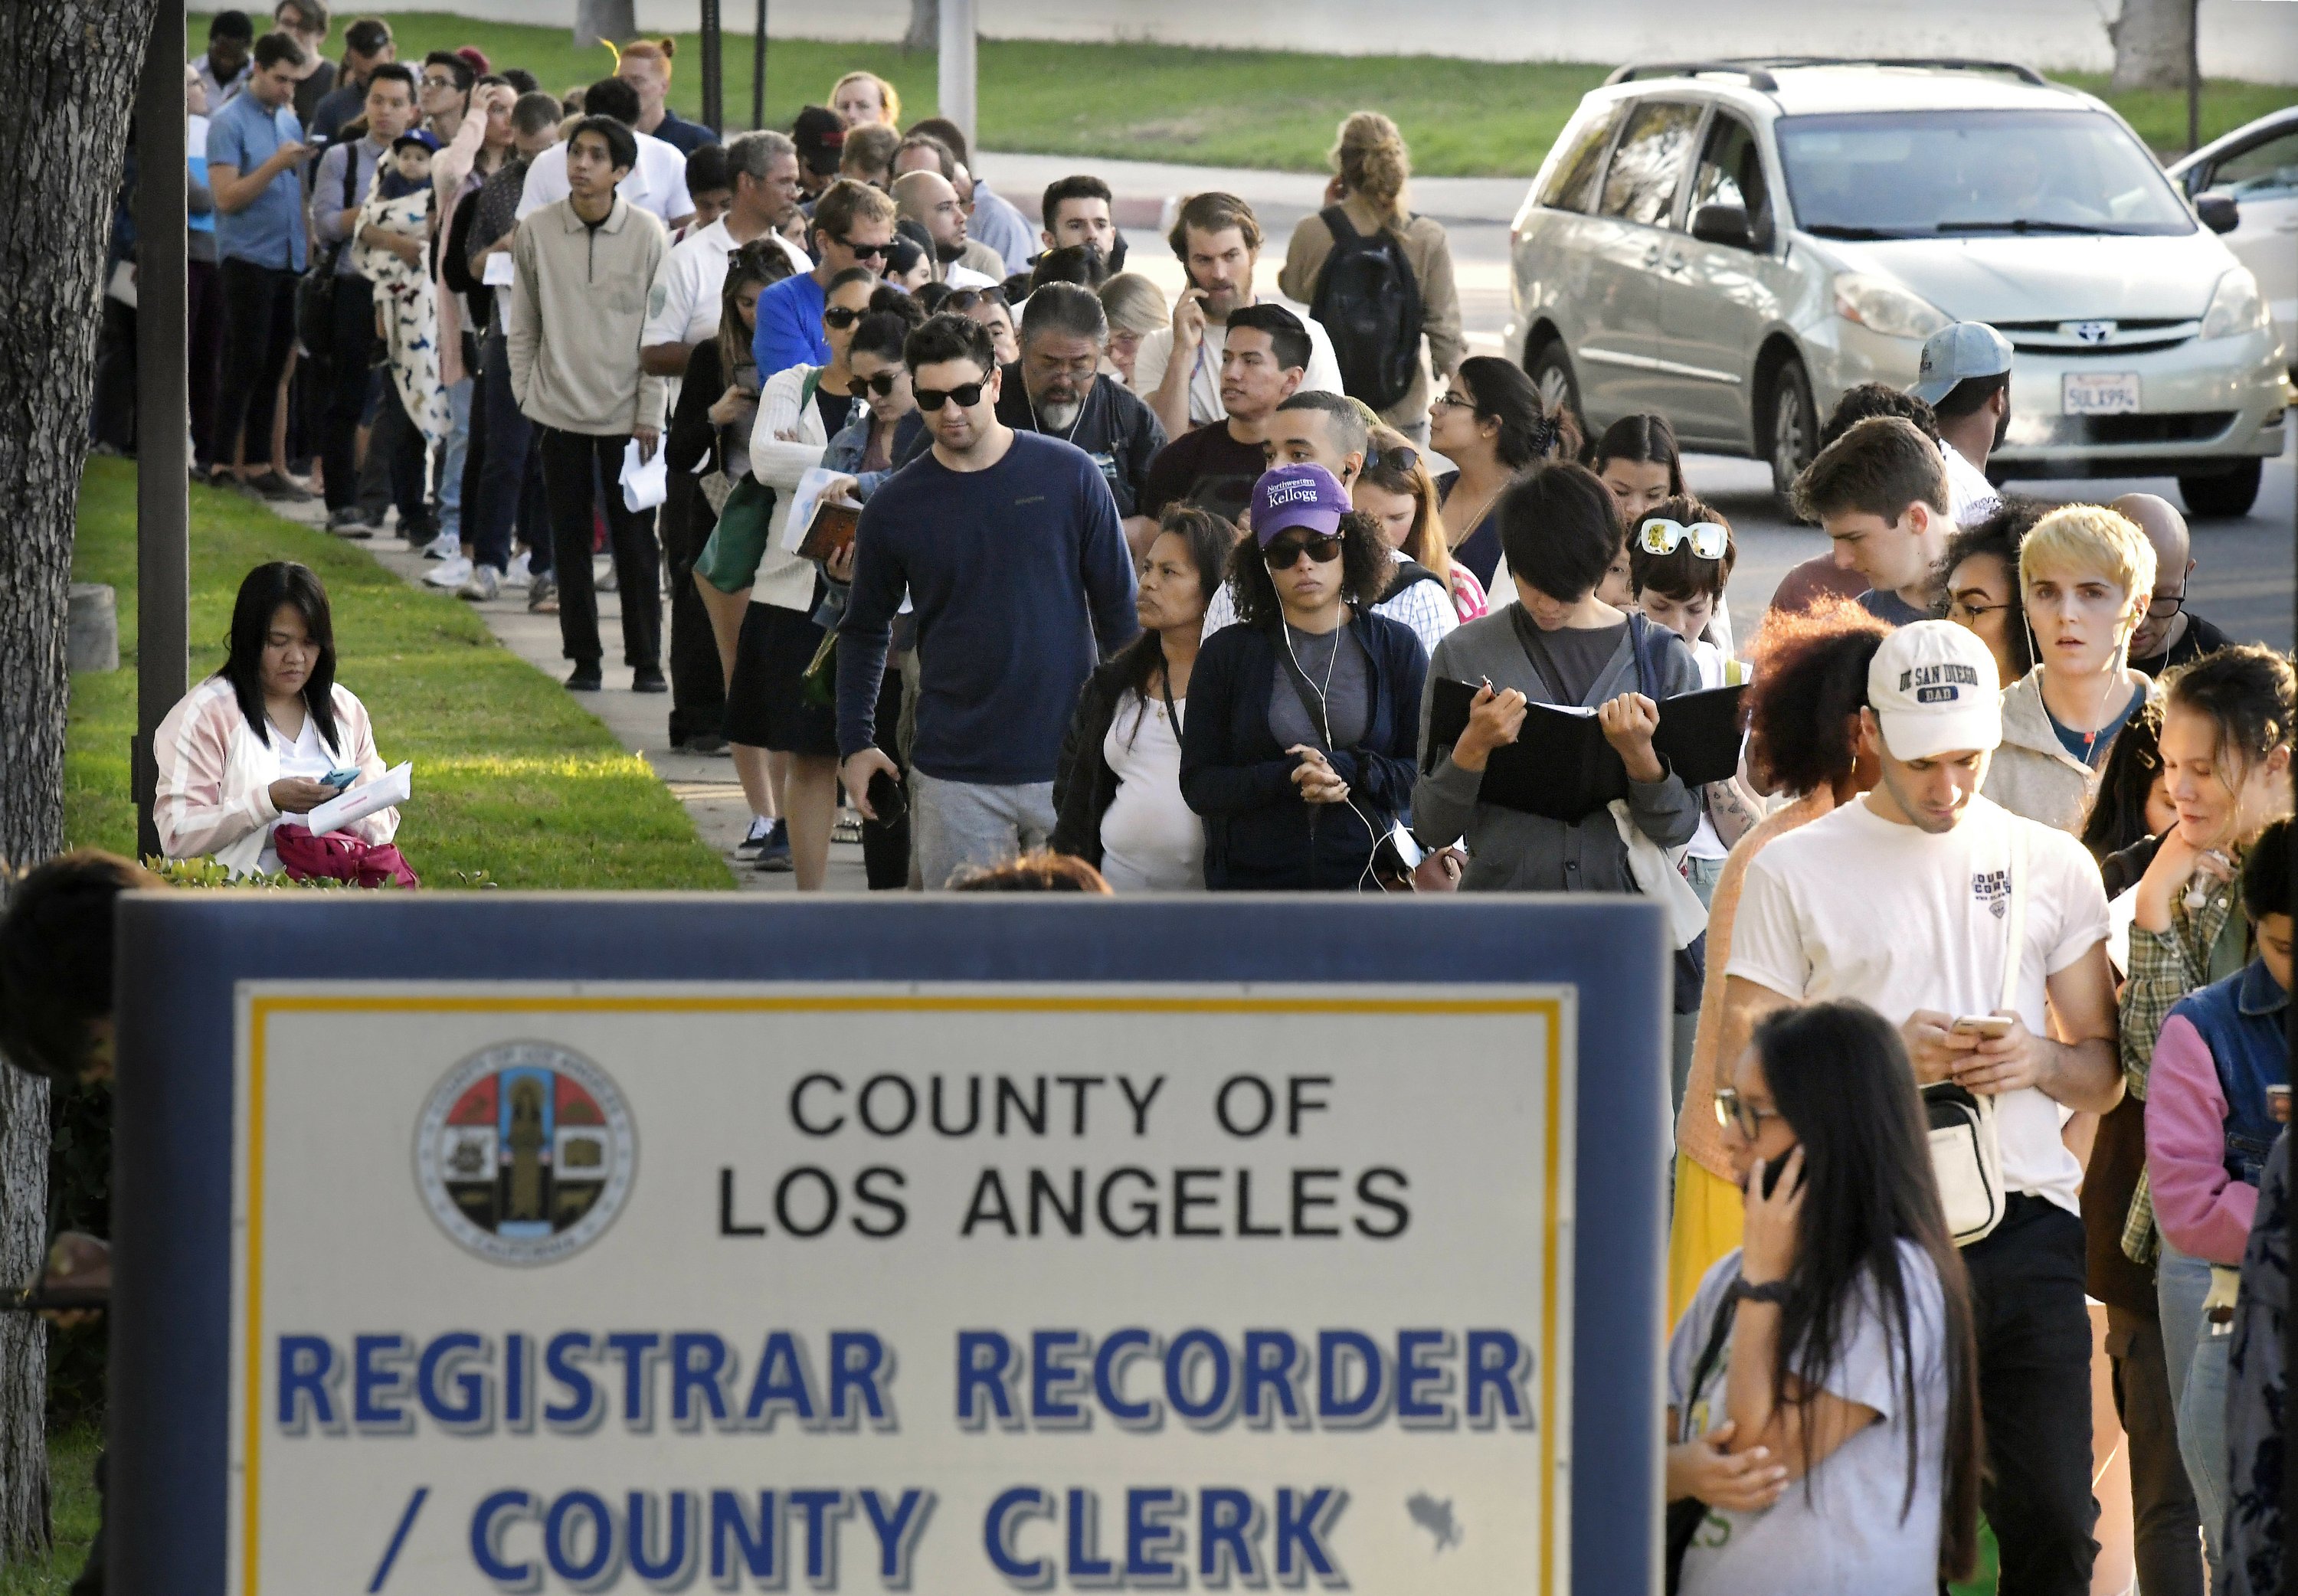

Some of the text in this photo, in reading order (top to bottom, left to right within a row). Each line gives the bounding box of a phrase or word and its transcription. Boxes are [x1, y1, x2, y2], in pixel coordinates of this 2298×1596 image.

[1267, 479, 1316, 495] Northwestern
[1268, 488, 1318, 508] Kellogg
[1915, 666, 1940, 686] SAN
[1943, 663, 1979, 686] DIEGO
[1924, 687, 1953, 702] DAD
[788, 1071, 1333, 1138] COUNTY OF
[718, 1164, 1411, 1240] LOS ANGELES
[275, 1327, 1534, 1437] REGISTRAR RECORDER
[368, 1486, 1350, 1595] / COUNTY CLERK
